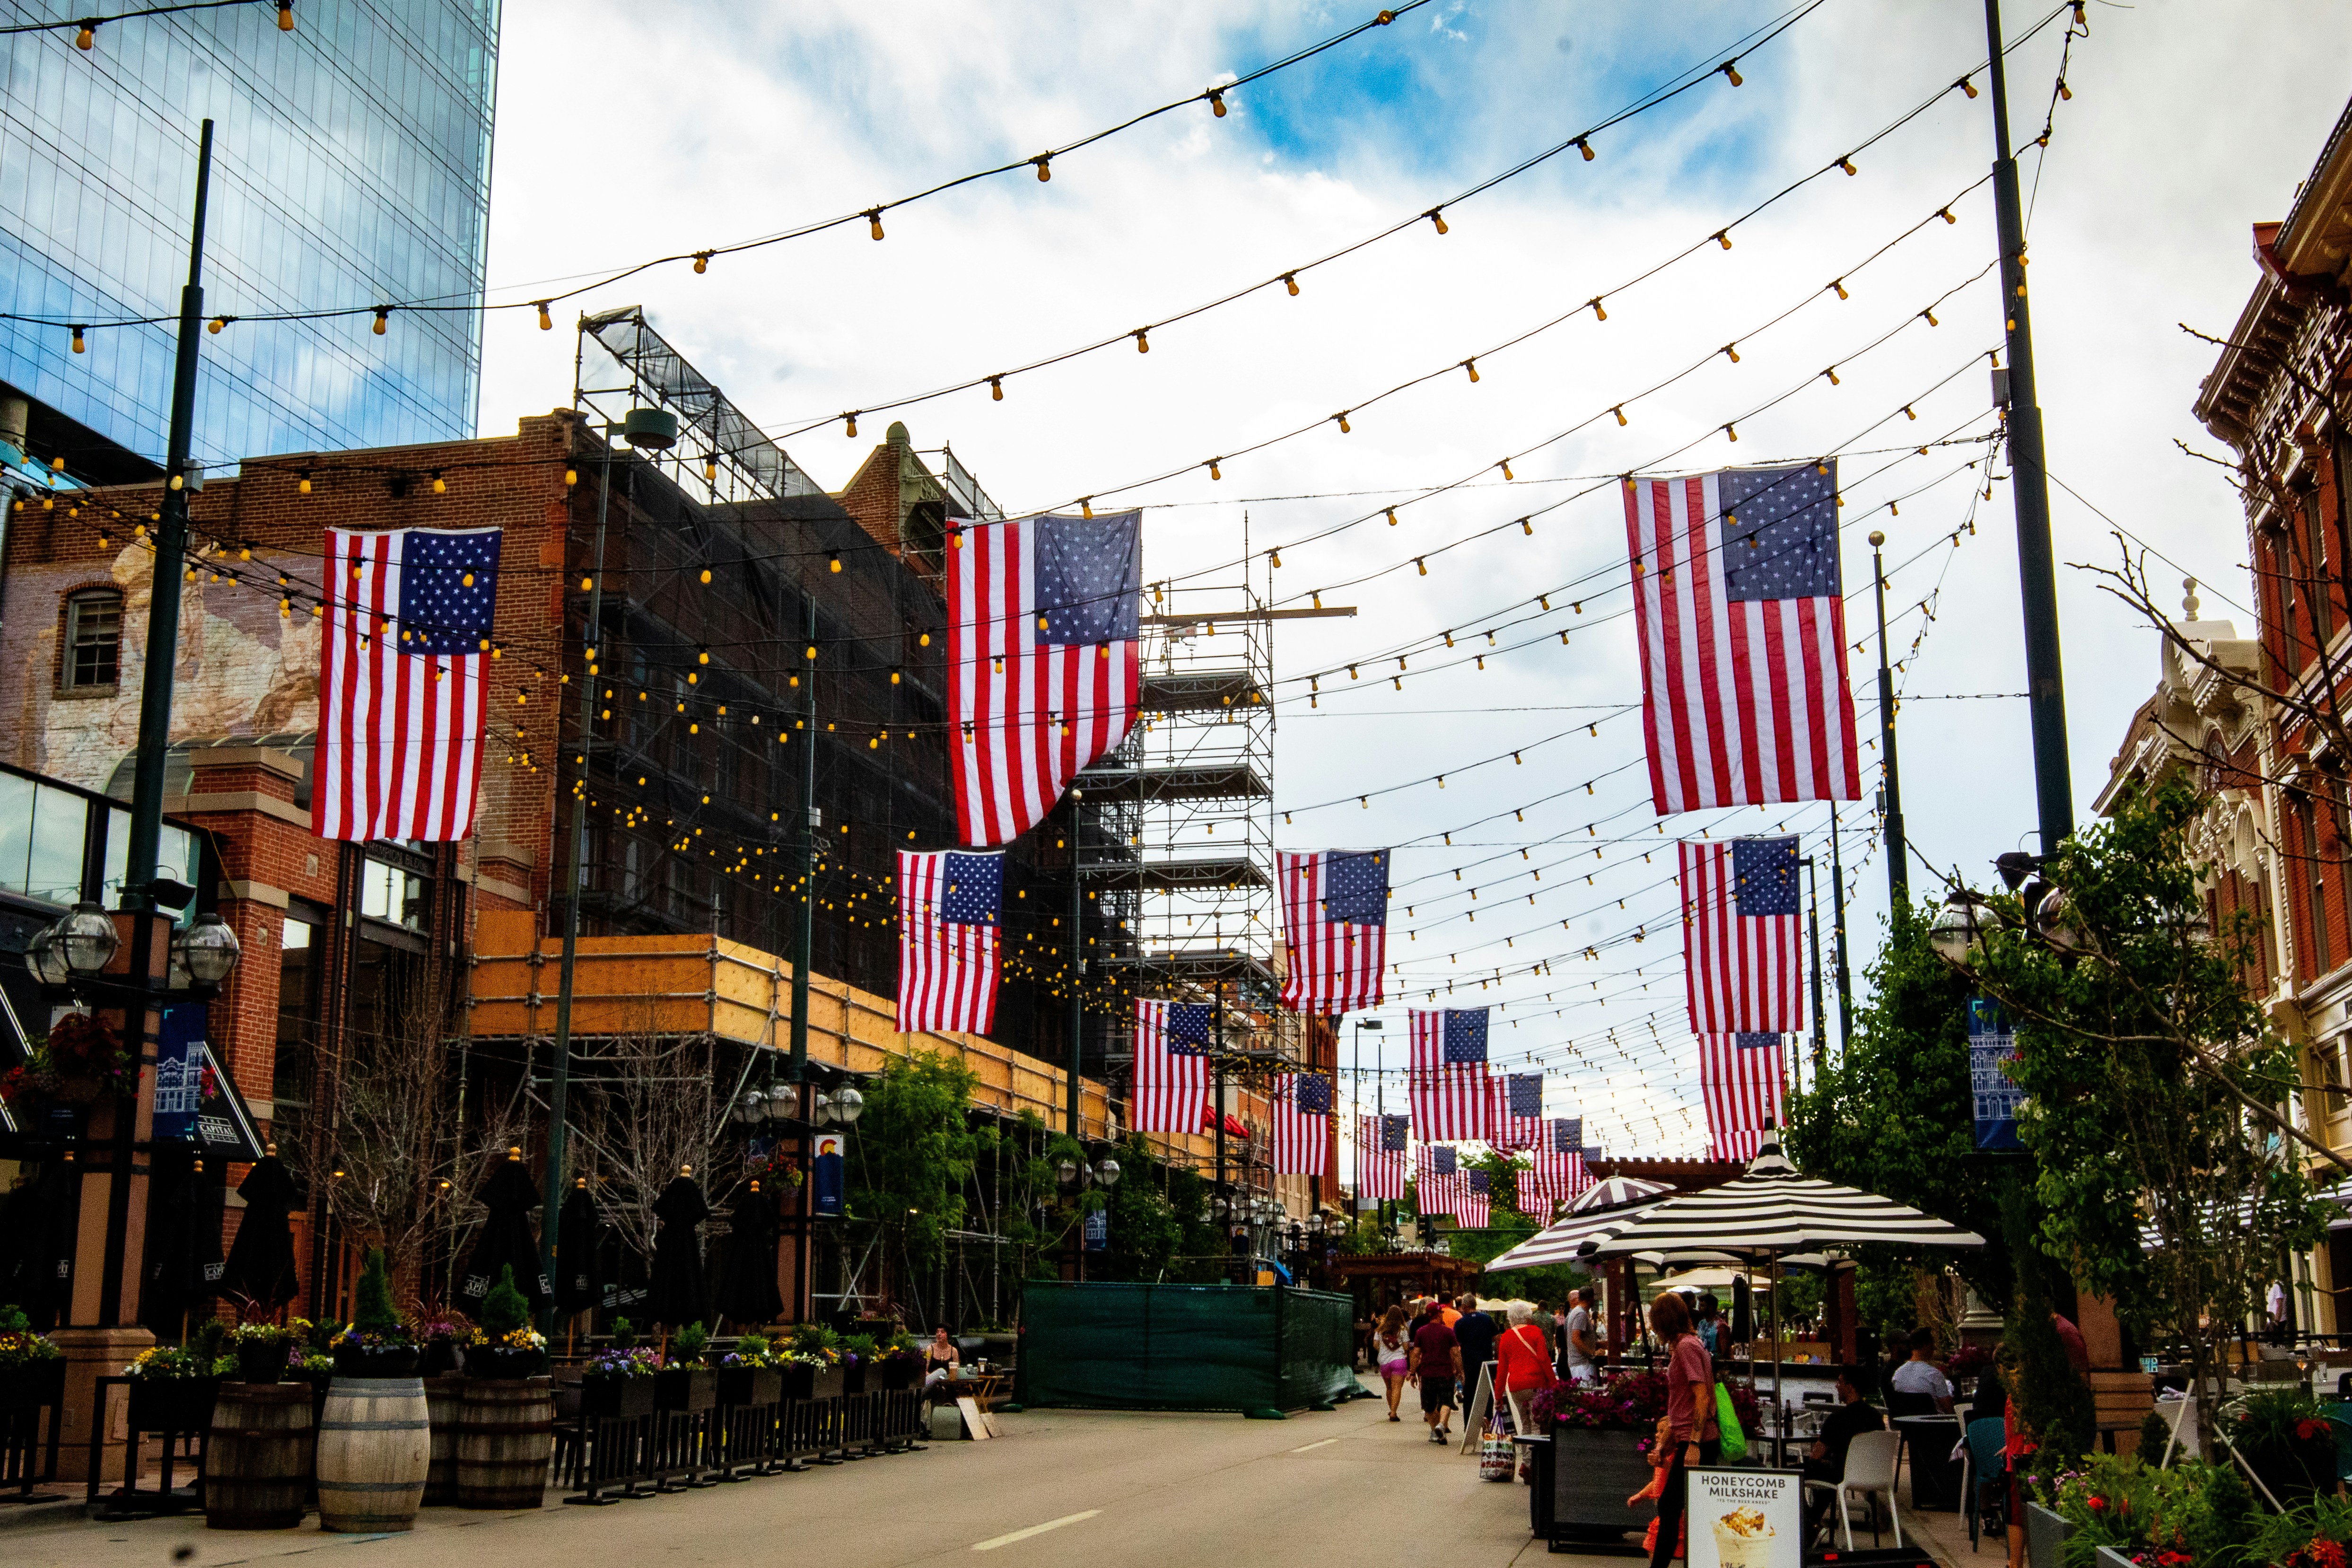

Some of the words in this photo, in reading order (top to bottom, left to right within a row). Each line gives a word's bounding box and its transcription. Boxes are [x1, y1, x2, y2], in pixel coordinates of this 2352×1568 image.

[199, 1124, 237, 1135] CAPITAL
[1702, 1475, 1785, 1488] HONEYCOMB
[1709, 1487, 1778, 1499] MILKSHAKE
